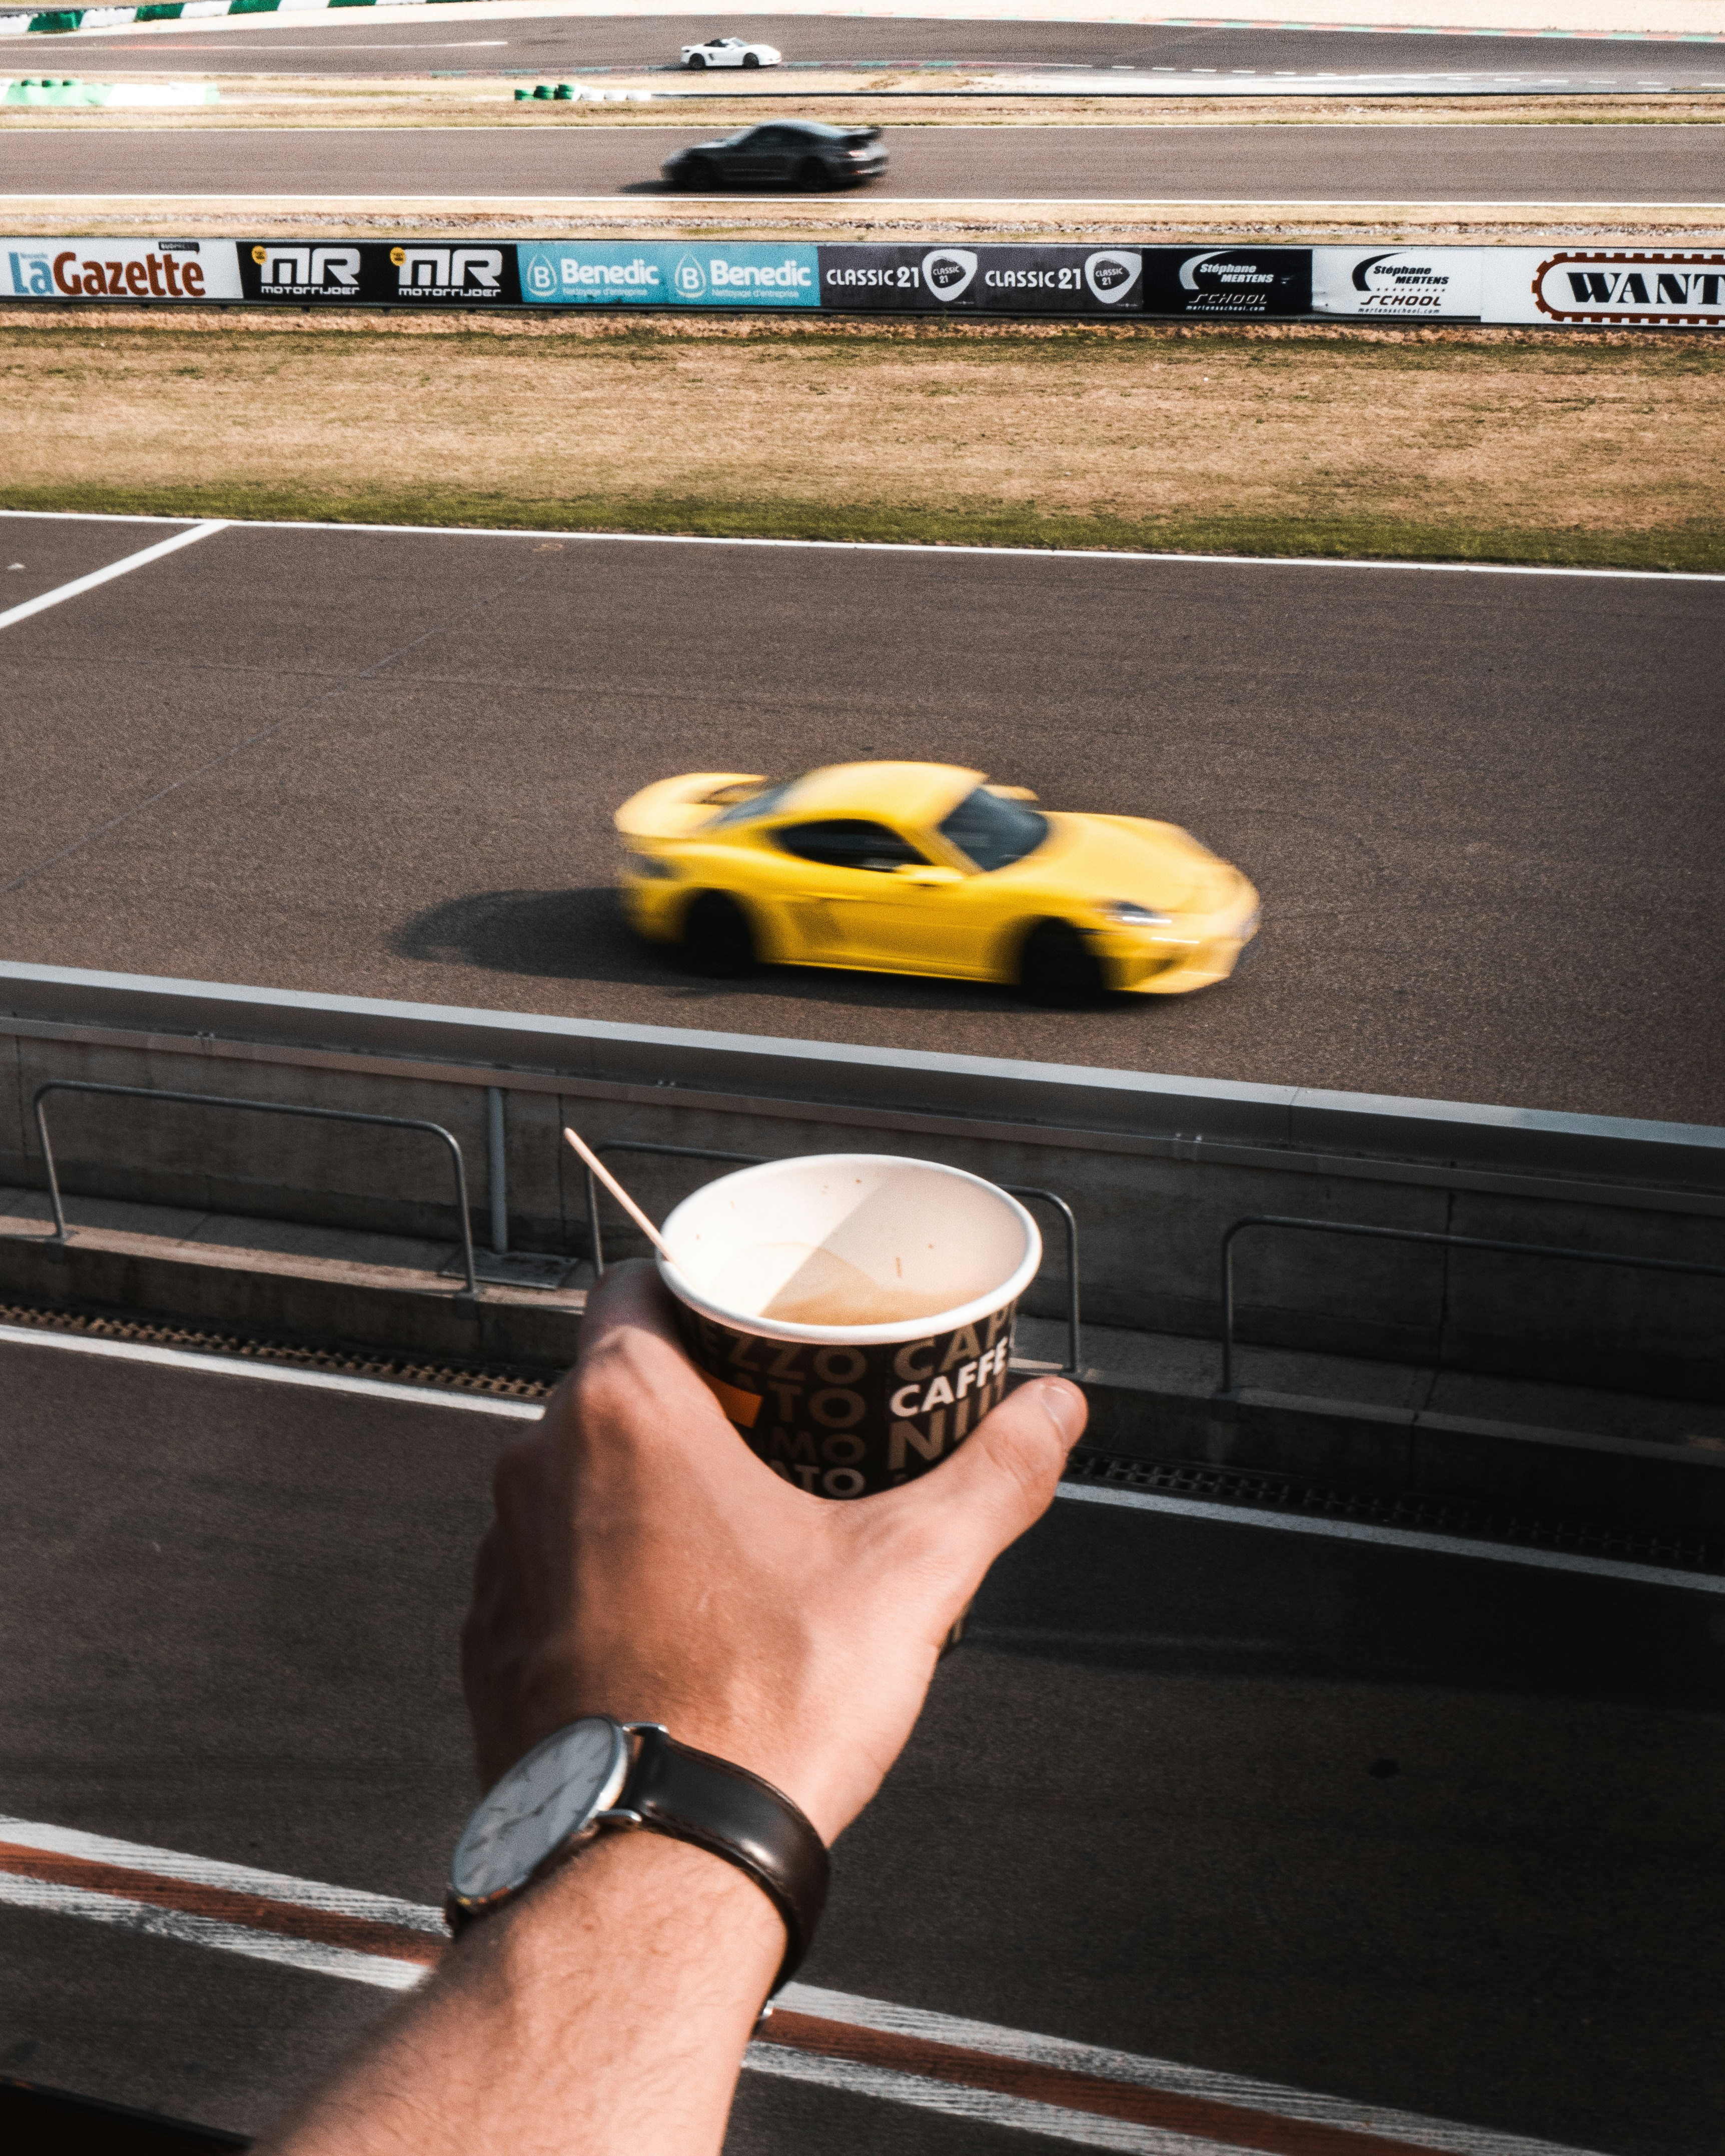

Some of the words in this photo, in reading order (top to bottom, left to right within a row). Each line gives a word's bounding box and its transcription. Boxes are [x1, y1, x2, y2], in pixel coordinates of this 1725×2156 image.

[53, 251, 206, 296] Gazette
[534, 266, 550, 288] B
[561, 258, 659, 285] Benedic
[682, 267, 699, 289] B
[710, 259, 811, 286] Benedic
[826, 269, 895, 286] CLASSIC
[897, 266, 919, 288] 21
[939, 275, 949, 284] 21
[985, 270, 1055, 287] CLASSIC
[1058, 268, 1081, 290] 21
[1220, 274, 1274, 283] MERTENS
[1373, 265, 1431, 277] Stéphane
[1102, 277, 1111, 286] 21
[1395, 276, 1449, 285] MERTENS
[1189, 294, 1267, 304] SCHOOL
[1360, 295, 1441, 306] SCHOOL
